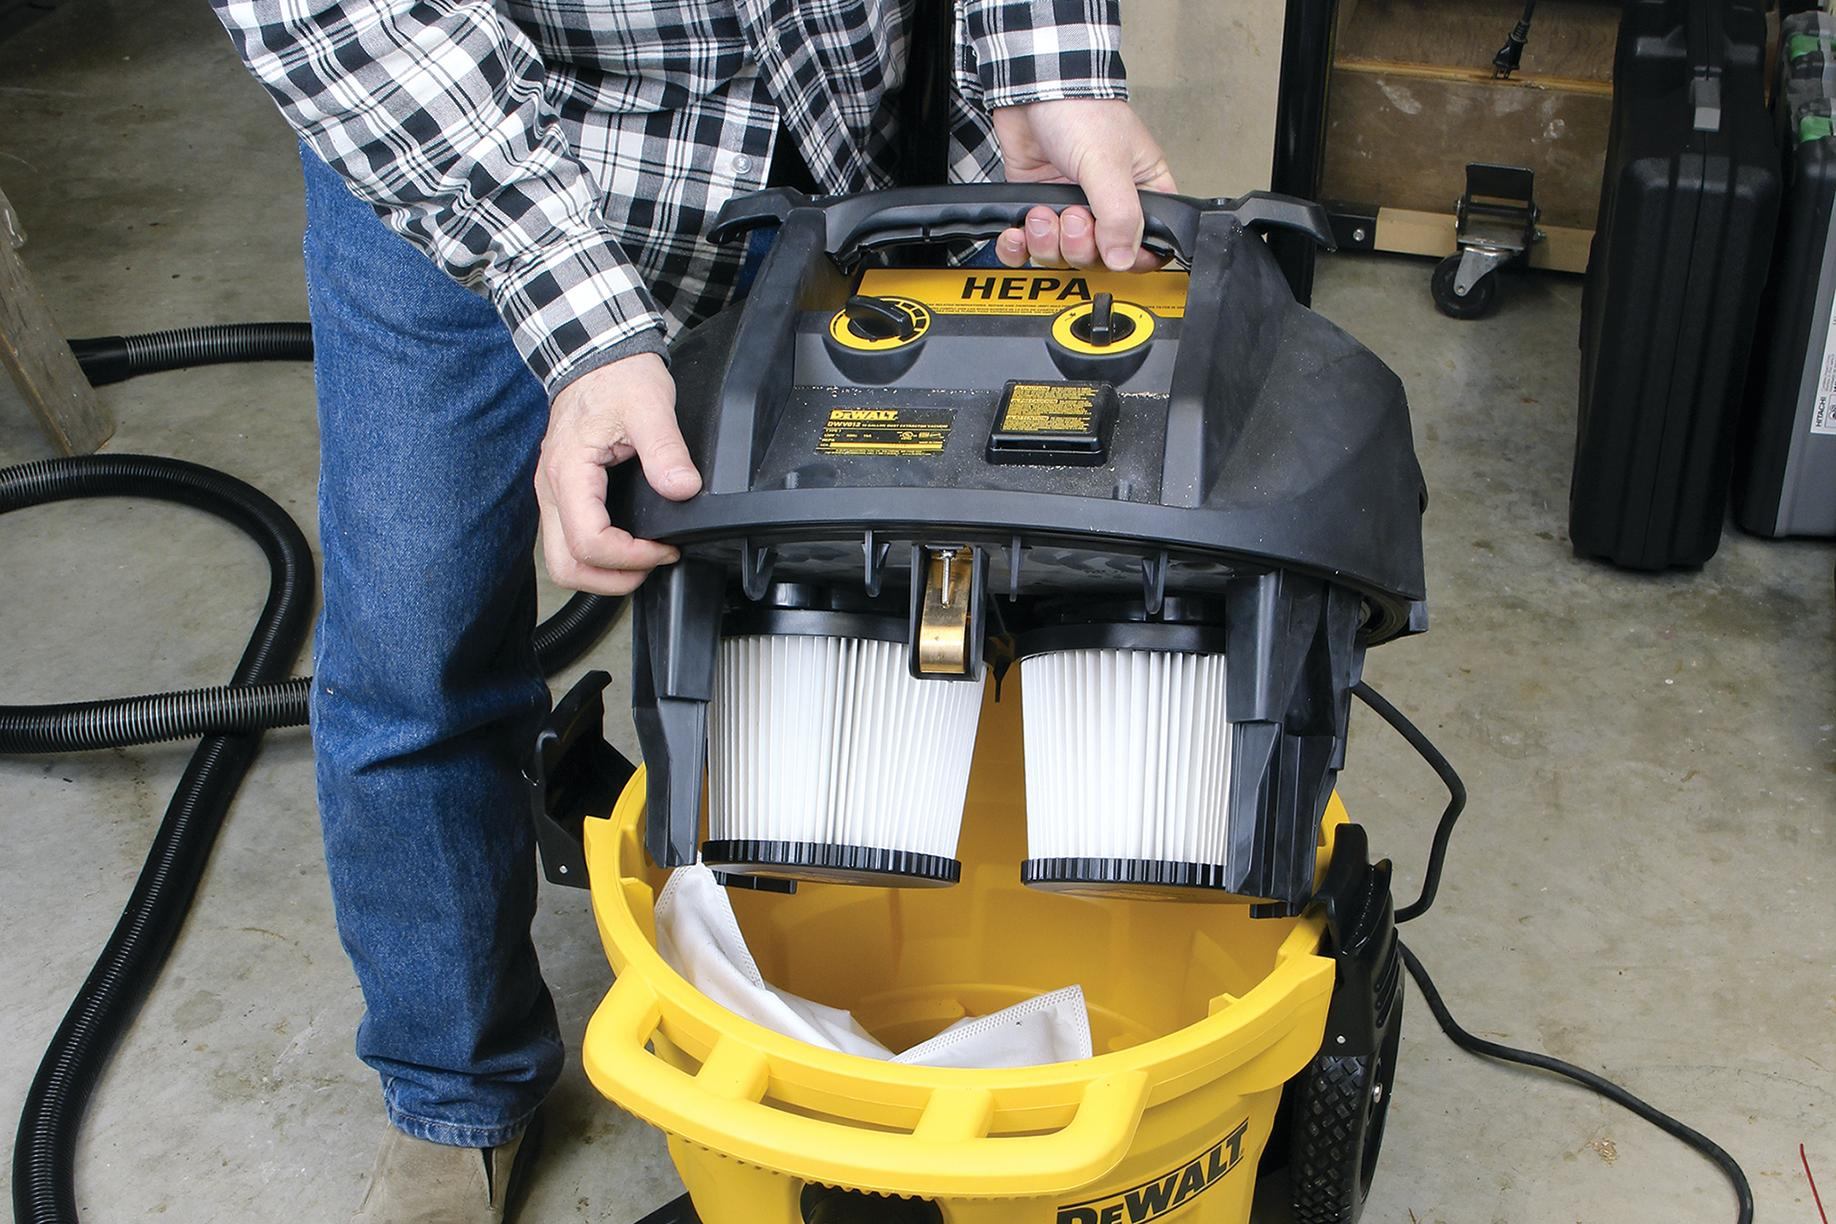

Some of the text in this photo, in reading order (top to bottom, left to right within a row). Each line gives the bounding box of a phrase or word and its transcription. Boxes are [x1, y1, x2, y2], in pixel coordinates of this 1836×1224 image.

[961, 277, 1092, 300] HEPA
[830, 409, 898, 420] DEWALT
[1815, 397, 1827, 427] HITACHI
